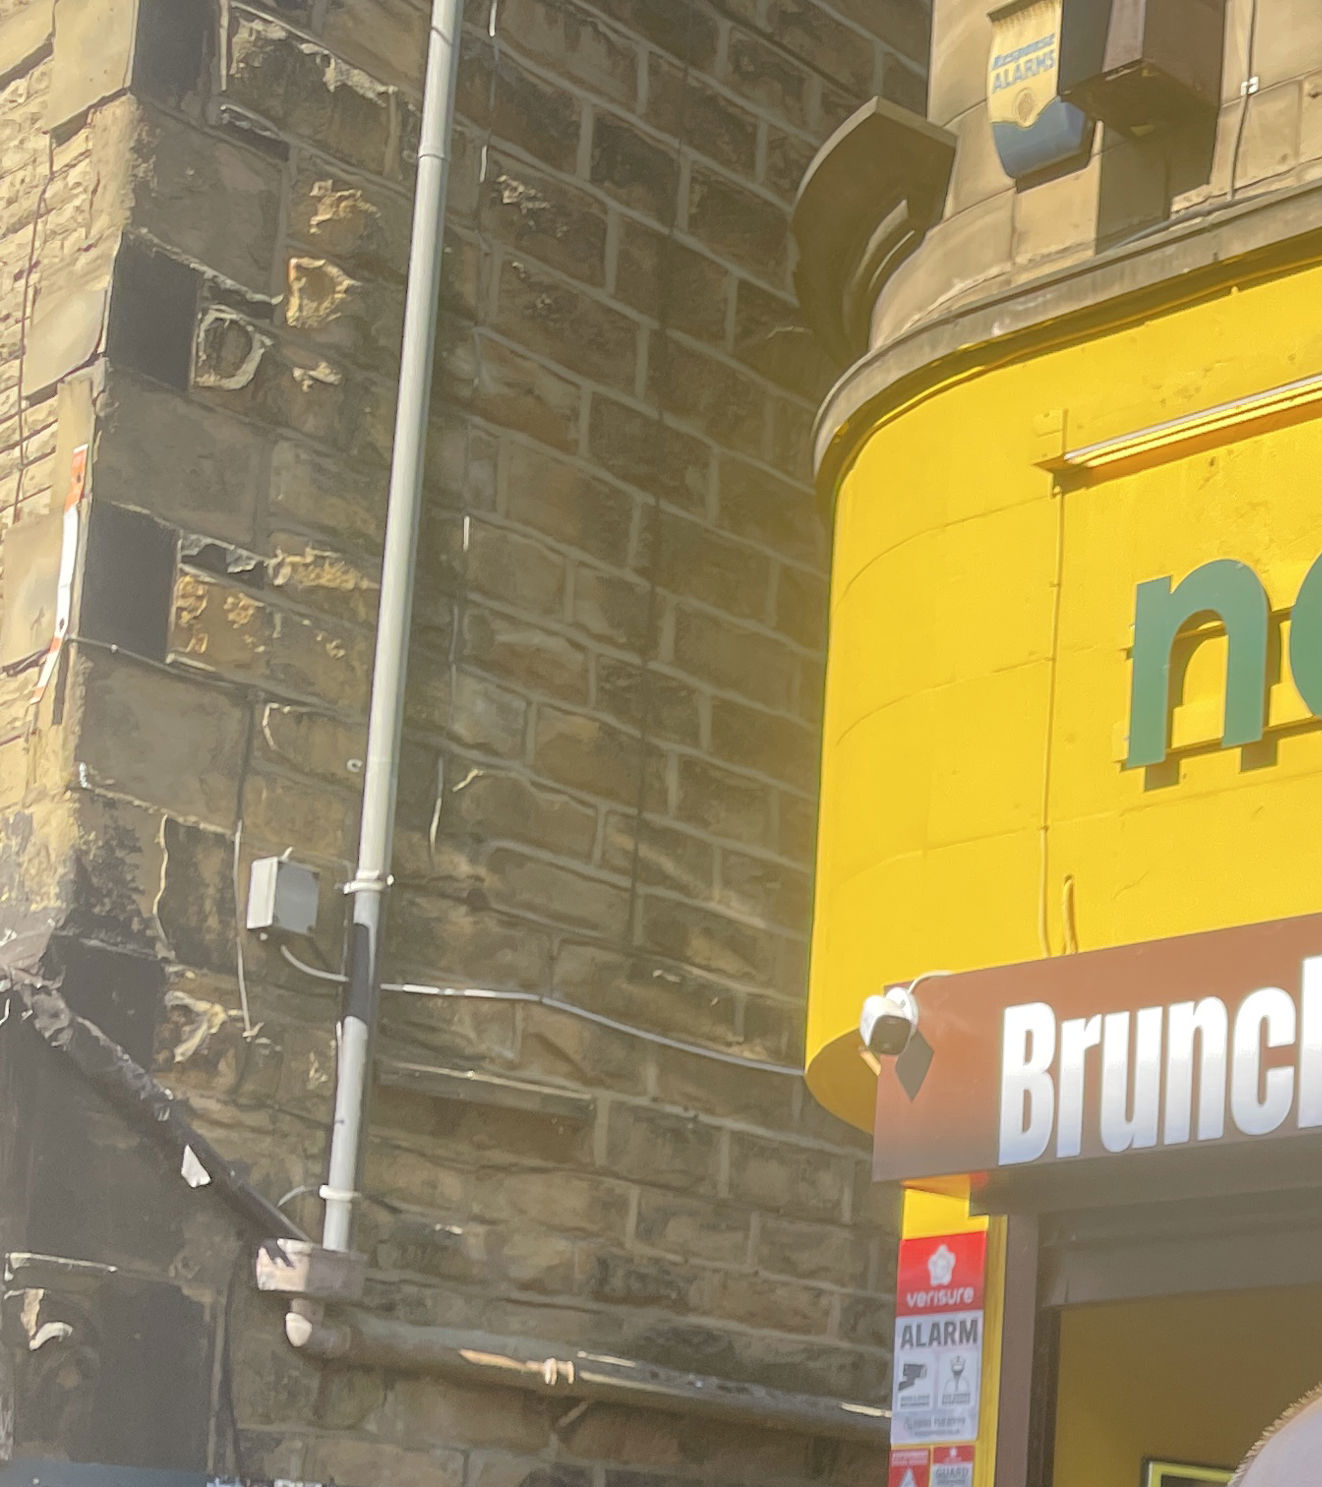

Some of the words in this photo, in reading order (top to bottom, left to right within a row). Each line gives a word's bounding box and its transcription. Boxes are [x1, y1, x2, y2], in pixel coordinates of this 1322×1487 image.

[992, 49, 1054, 93] ALARMS
[907, 1287, 974, 1308] verisure
[901, 1320, 977, 1349] ALARM
